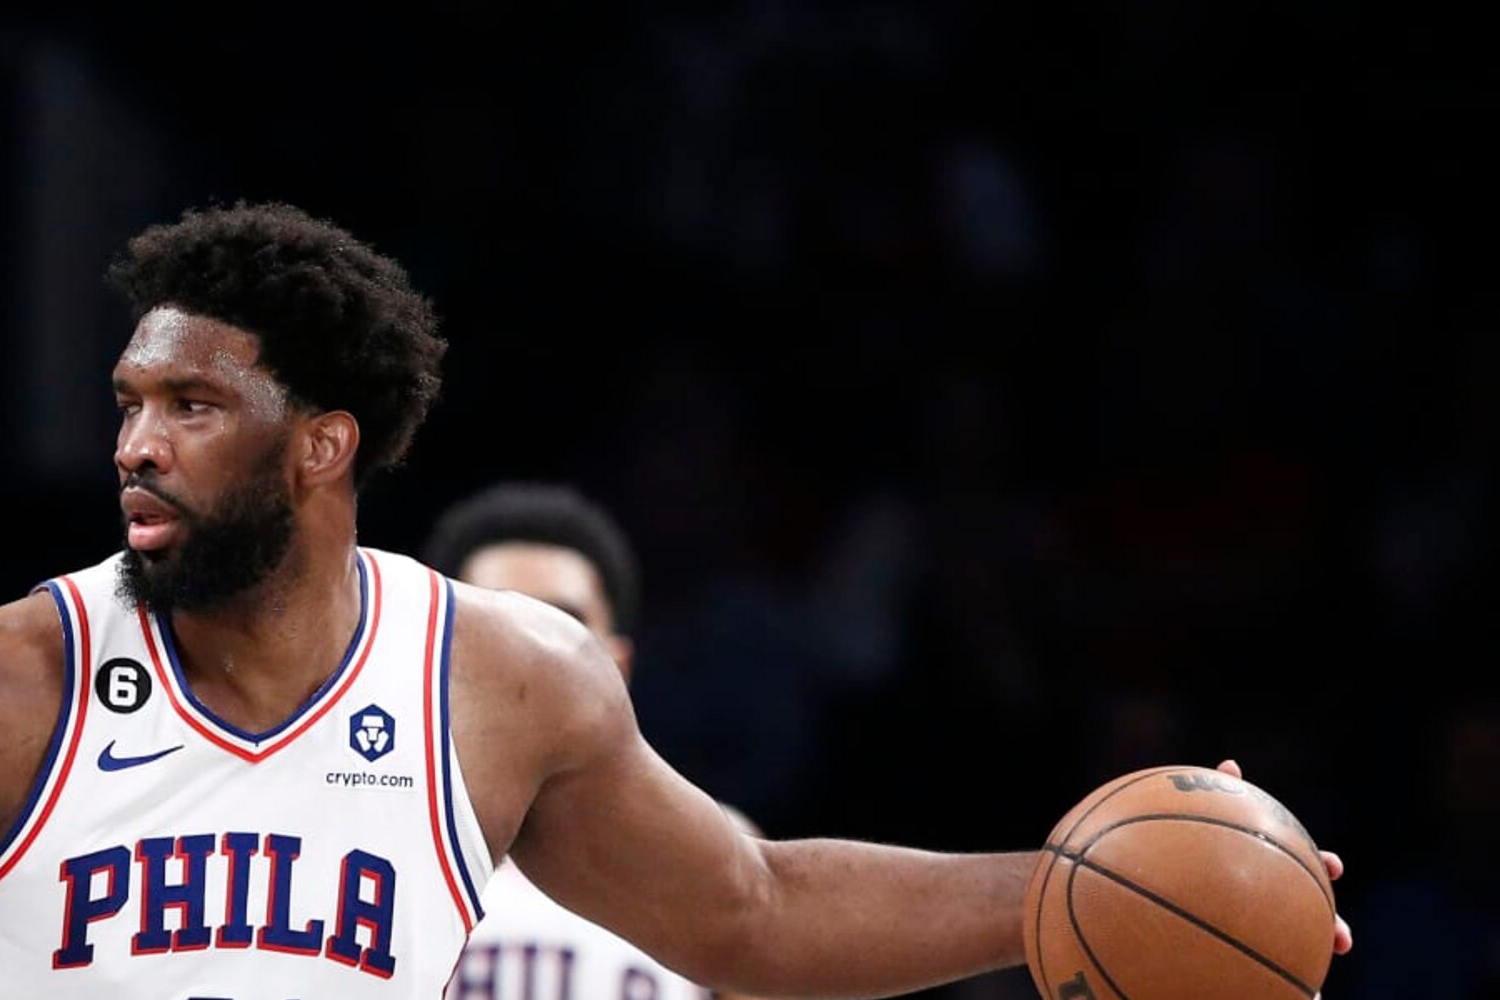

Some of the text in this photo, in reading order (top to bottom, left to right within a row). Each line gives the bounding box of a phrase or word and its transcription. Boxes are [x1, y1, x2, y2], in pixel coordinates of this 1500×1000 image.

[108, 665, 139, 708] 6
[325, 770, 414, 788] crypto.com
[52, 832, 397, 980] PHILA
